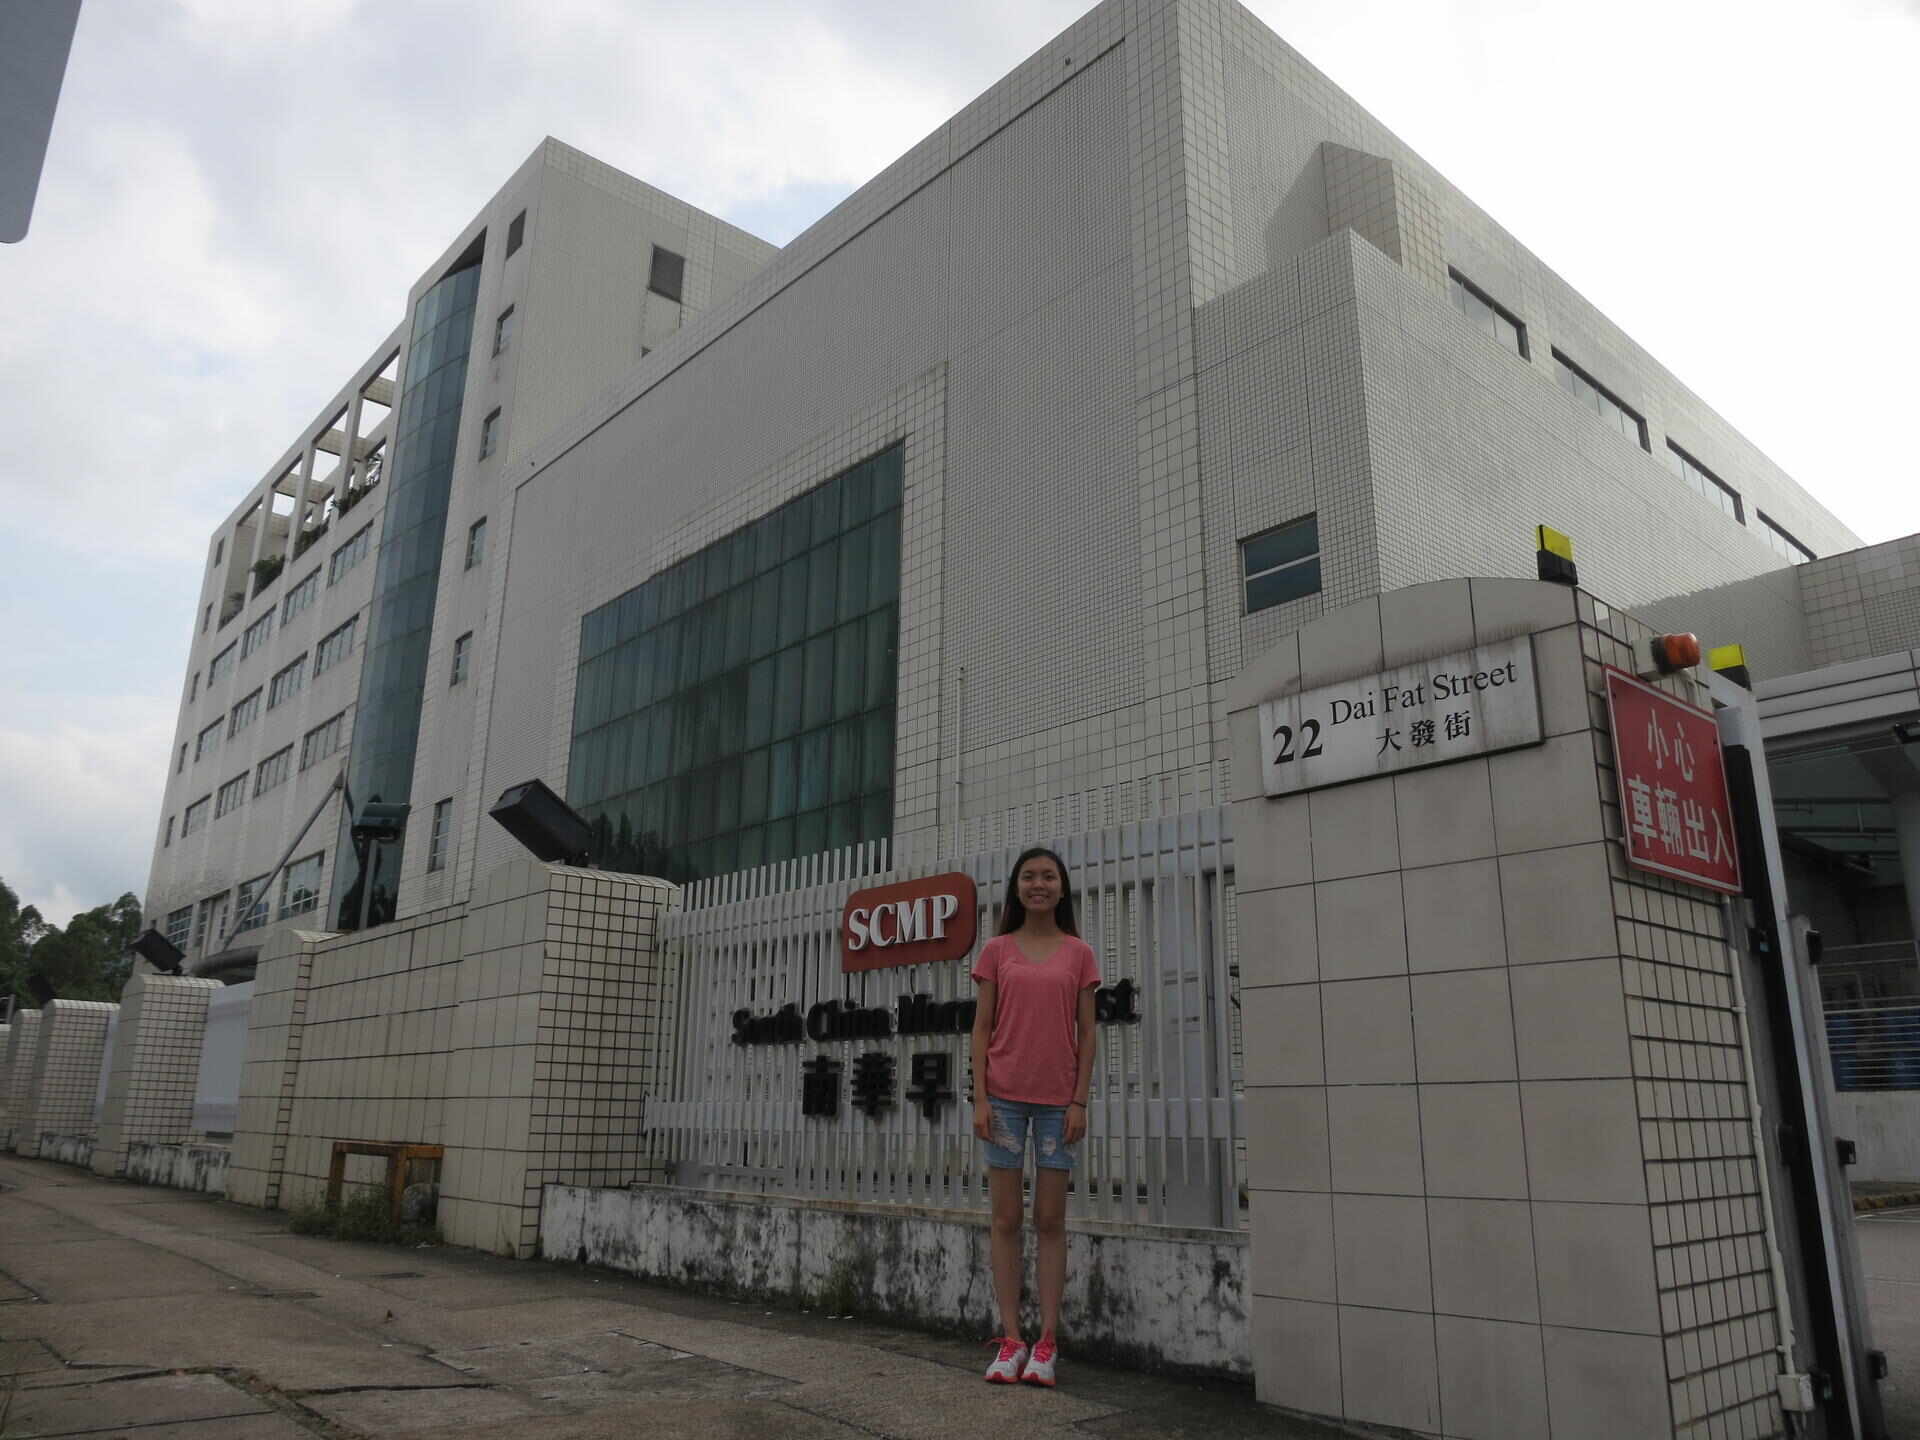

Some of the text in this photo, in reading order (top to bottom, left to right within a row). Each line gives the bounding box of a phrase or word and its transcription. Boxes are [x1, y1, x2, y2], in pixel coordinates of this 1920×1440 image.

[1330, 660, 1517, 726] Dai Fat Street
[1272, 718, 1323, 765] 22
[1376, 710, 1471, 756] 大發街
[1647, 708, 1695, 783] 小心
[848, 894, 959, 952] SCMP
[807, 1000, 893, 1042] China
[802, 1053, 974, 1121] 南華早
